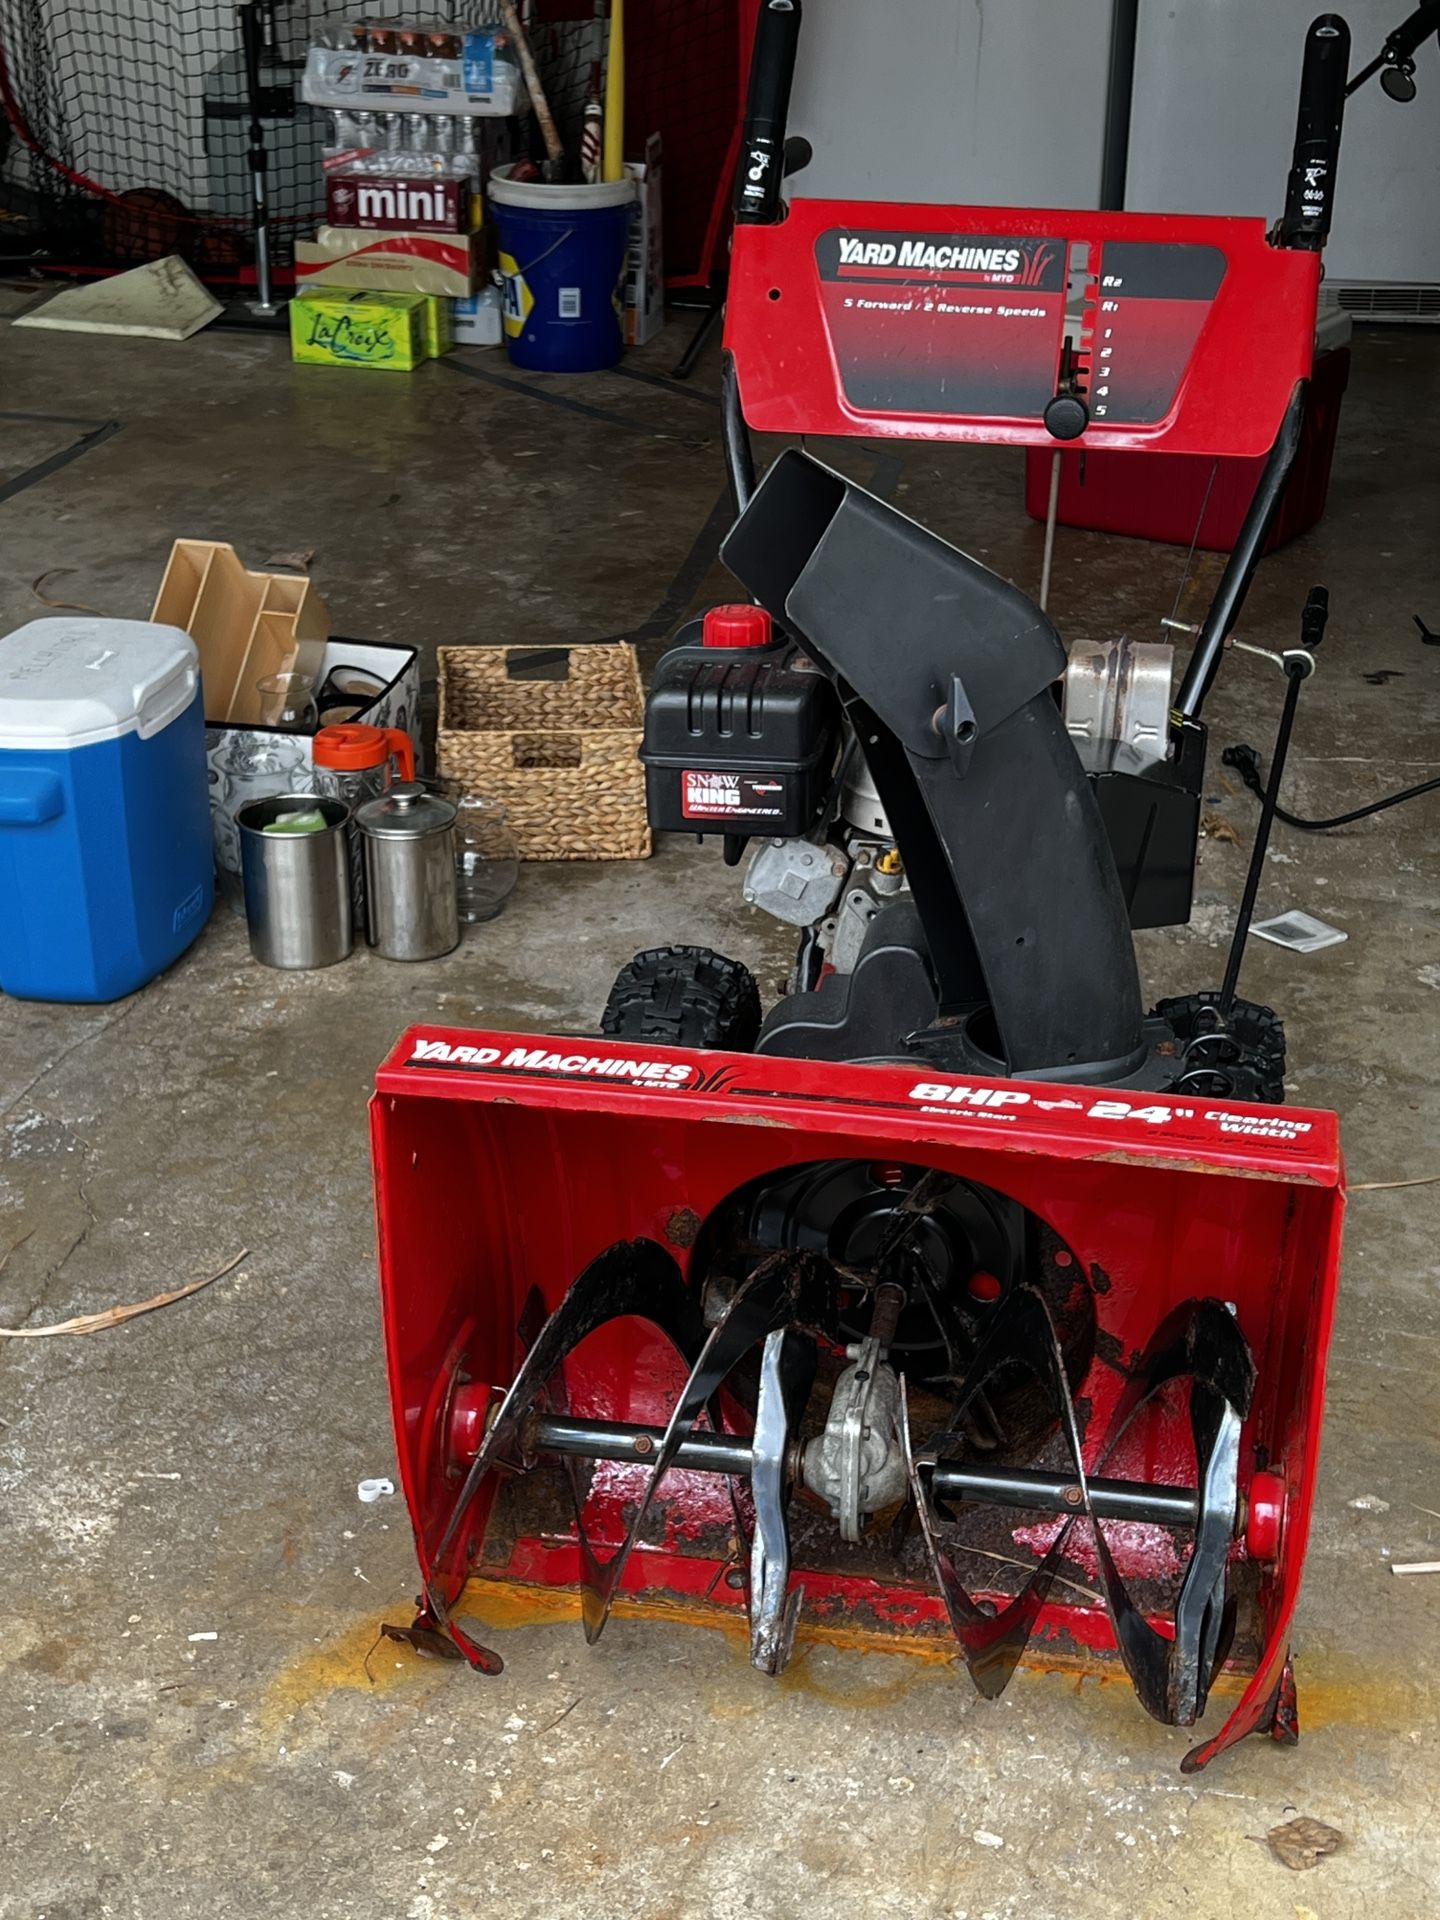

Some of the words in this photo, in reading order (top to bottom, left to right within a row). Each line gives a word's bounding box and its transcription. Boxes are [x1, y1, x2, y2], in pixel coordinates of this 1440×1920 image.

[357, 183, 445, 221] mini
[838, 238, 896, 266] YARD
[897, 241, 1020, 272] MACHINES
[991, 274, 1014, 283] MTD
[843, 298, 853, 307] 5
[857, 299, 912, 311] Forward
[923, 303, 934, 312] 2
[937, 303, 993, 314] Reverse
[996, 306, 1046, 318] Speeds
[1104, 328, 1112, 338] 1
[1100, 347, 1112, 358] 2
[1098, 367, 1111, 377] 3
[1096, 386, 1109, 396] 4
[1095, 405, 1107, 415] 5
[687, 788, 741, 806] KING
[410, 1039, 501, 1064] YARD
[501, 1048, 692, 1081] MACHINES
[643, 1081, 680, 1089] MTD
[908, 1083, 1031, 1107] 8HP
[1204, 1110, 1312, 1132] Clearing
[1220, 1121, 1297, 1139] Width
